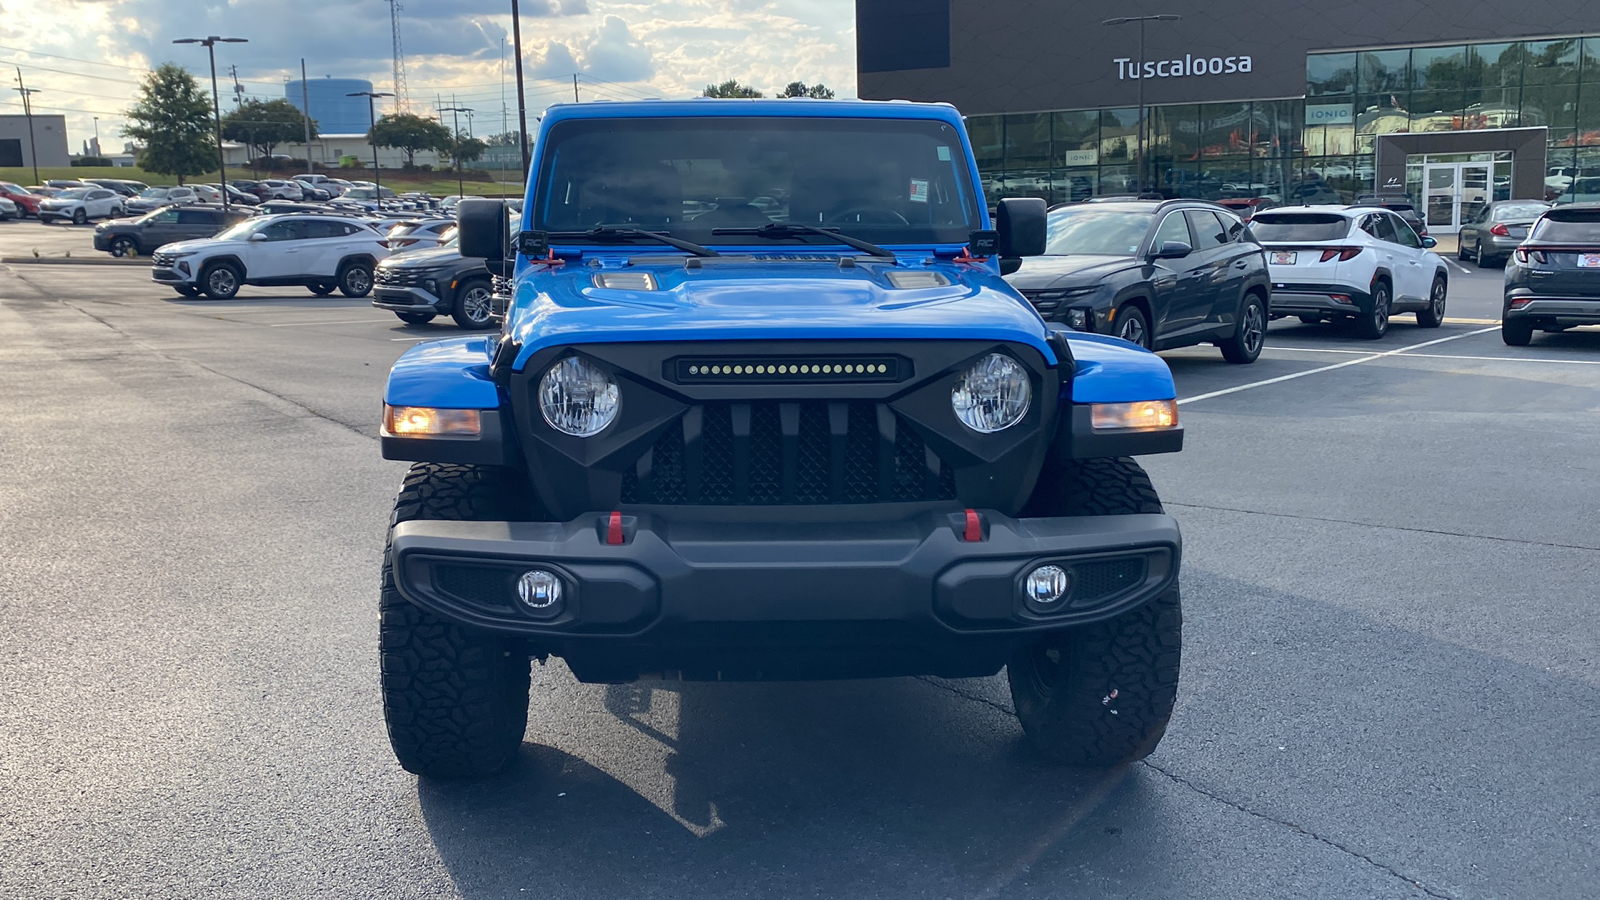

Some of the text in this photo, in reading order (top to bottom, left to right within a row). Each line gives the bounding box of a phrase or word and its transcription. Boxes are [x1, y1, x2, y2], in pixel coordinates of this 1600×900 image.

[1113, 54, 1252, 80] Tuscaloosa
[524, 238, 542, 247] RC
[976, 239, 994, 247] RC
